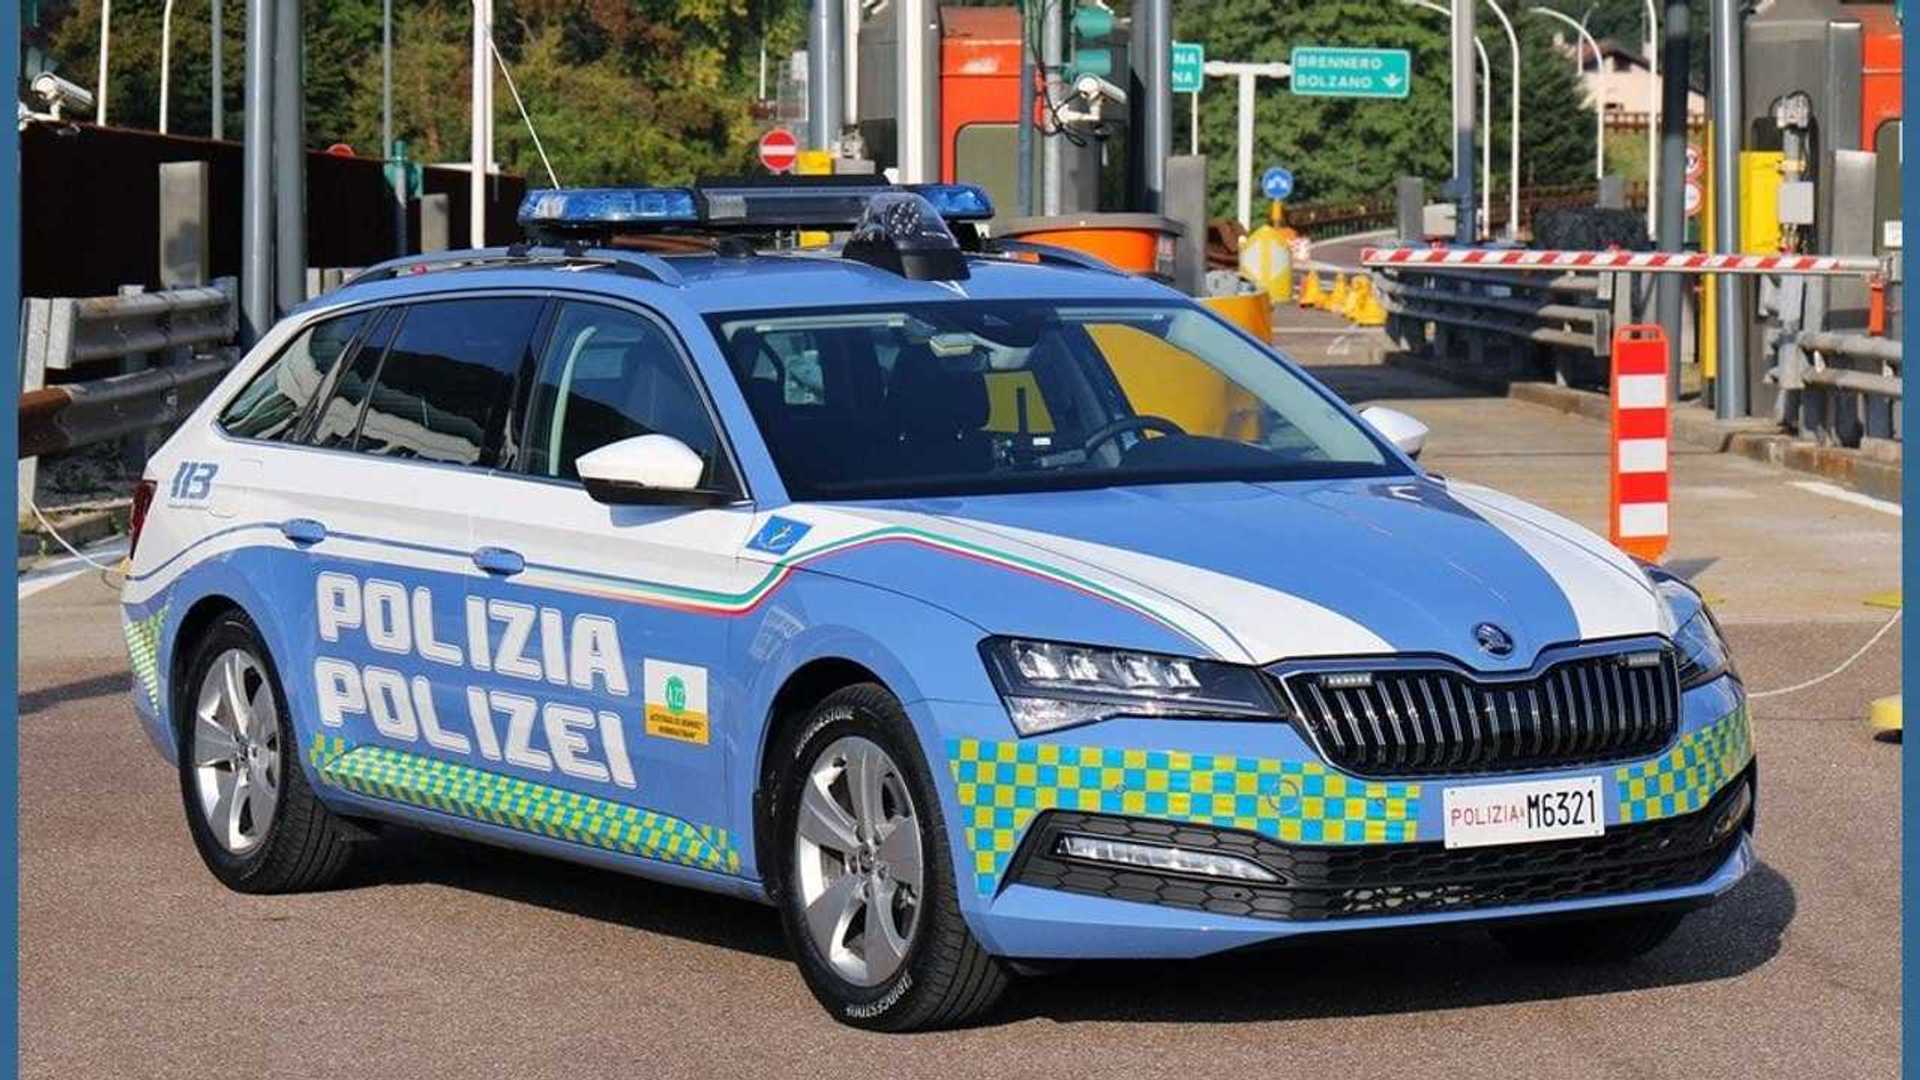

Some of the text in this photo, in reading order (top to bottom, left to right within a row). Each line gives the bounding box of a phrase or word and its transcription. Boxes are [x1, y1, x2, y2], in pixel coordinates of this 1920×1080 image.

[1296, 74, 1373, 89] BOLZANO
[1297, 54, 1383, 71] BRENNERO
[170, 461, 219, 500] 113
[316, 570, 630, 697] POLIZIA
[314, 656, 637, 790] POLIZEI
[1451, 789, 1596, 829] POLIZIA M6321
